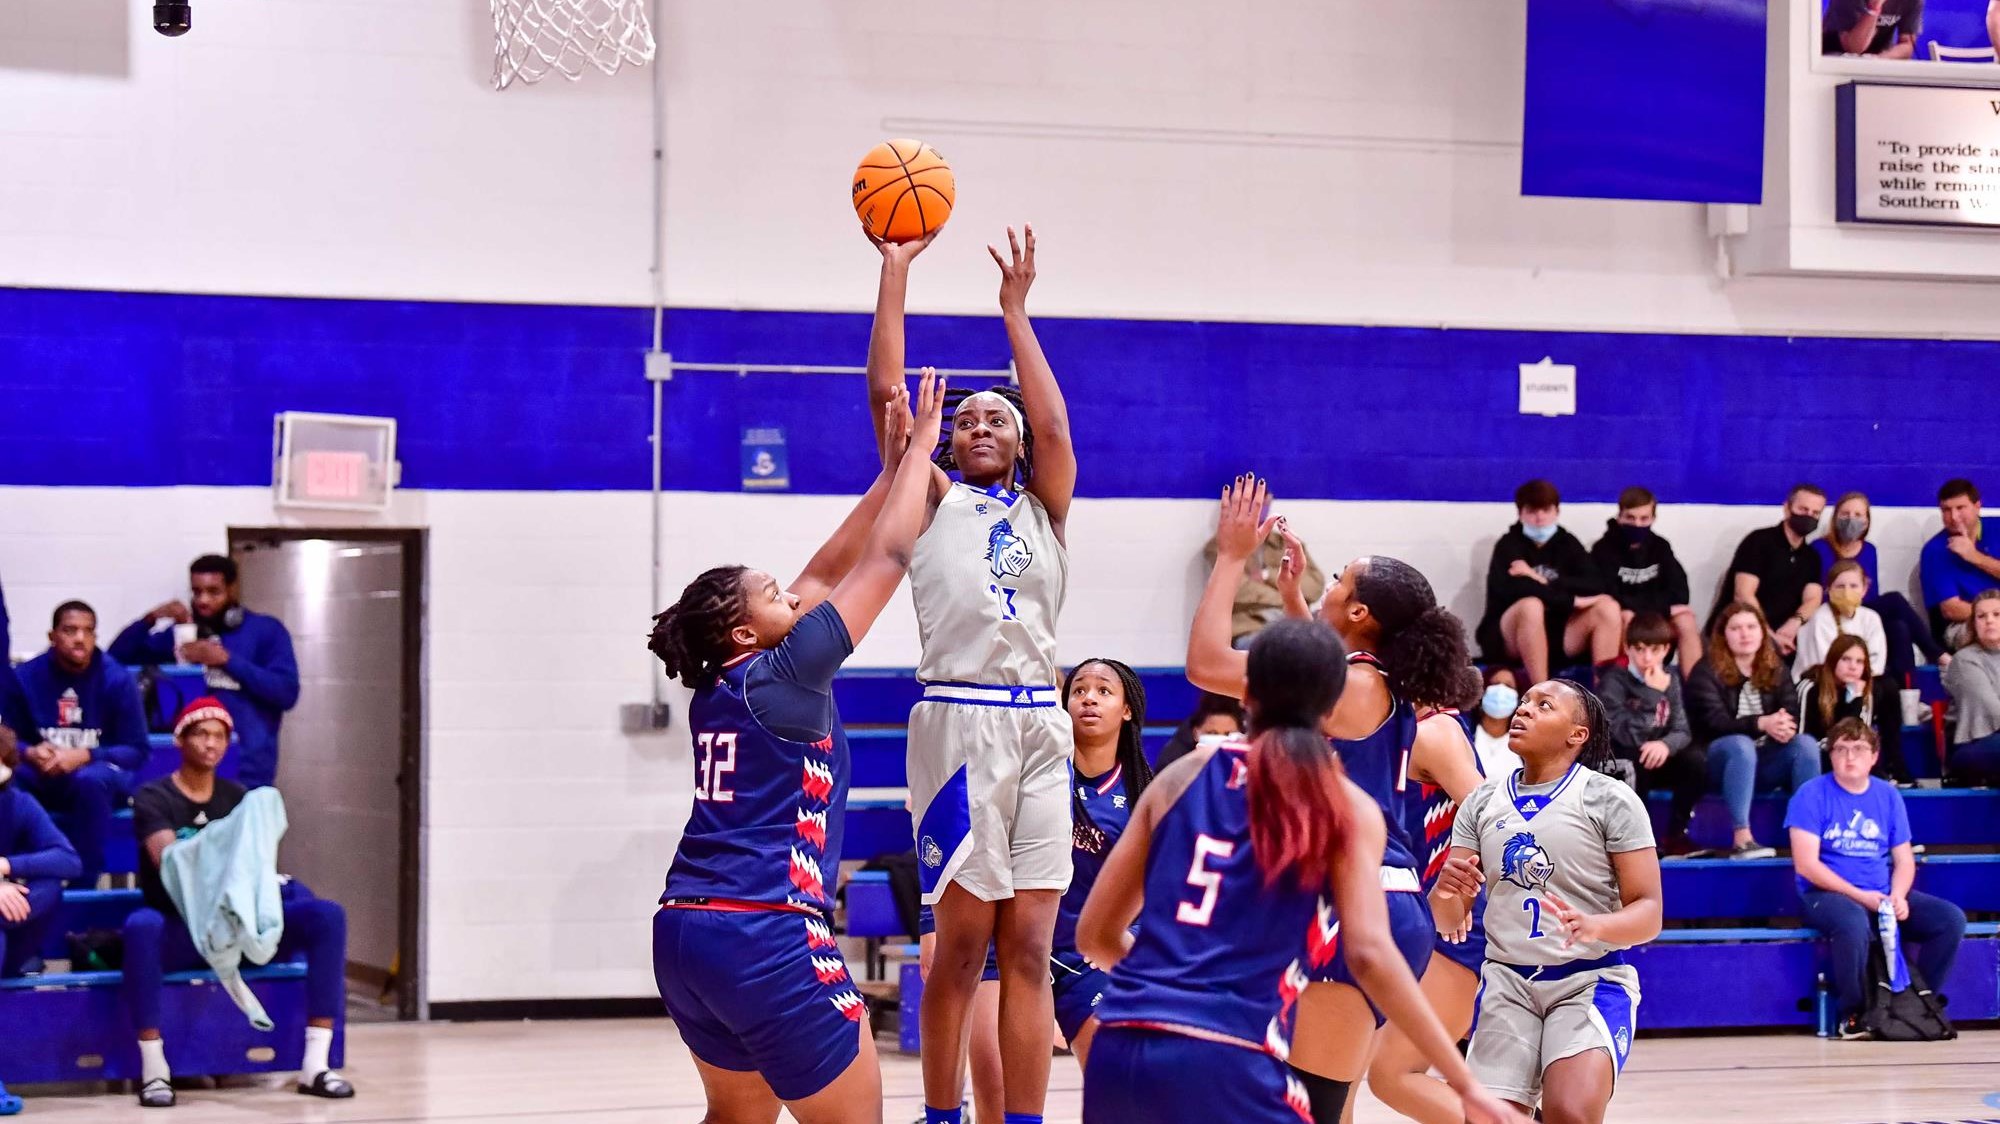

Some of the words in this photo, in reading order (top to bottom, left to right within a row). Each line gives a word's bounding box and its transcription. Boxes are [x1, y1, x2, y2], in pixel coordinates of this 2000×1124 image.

[1919, 143, 1982, 158] provide
[1879, 159, 1924, 173] raise
[1933, 161, 1960, 174] the
[1879, 177, 1926, 191] while
[1879, 194, 1960, 209] Southern
[695, 732, 738, 801] 32
[1176, 834, 1234, 926] 5
[1523, 897, 1545, 939] 2
